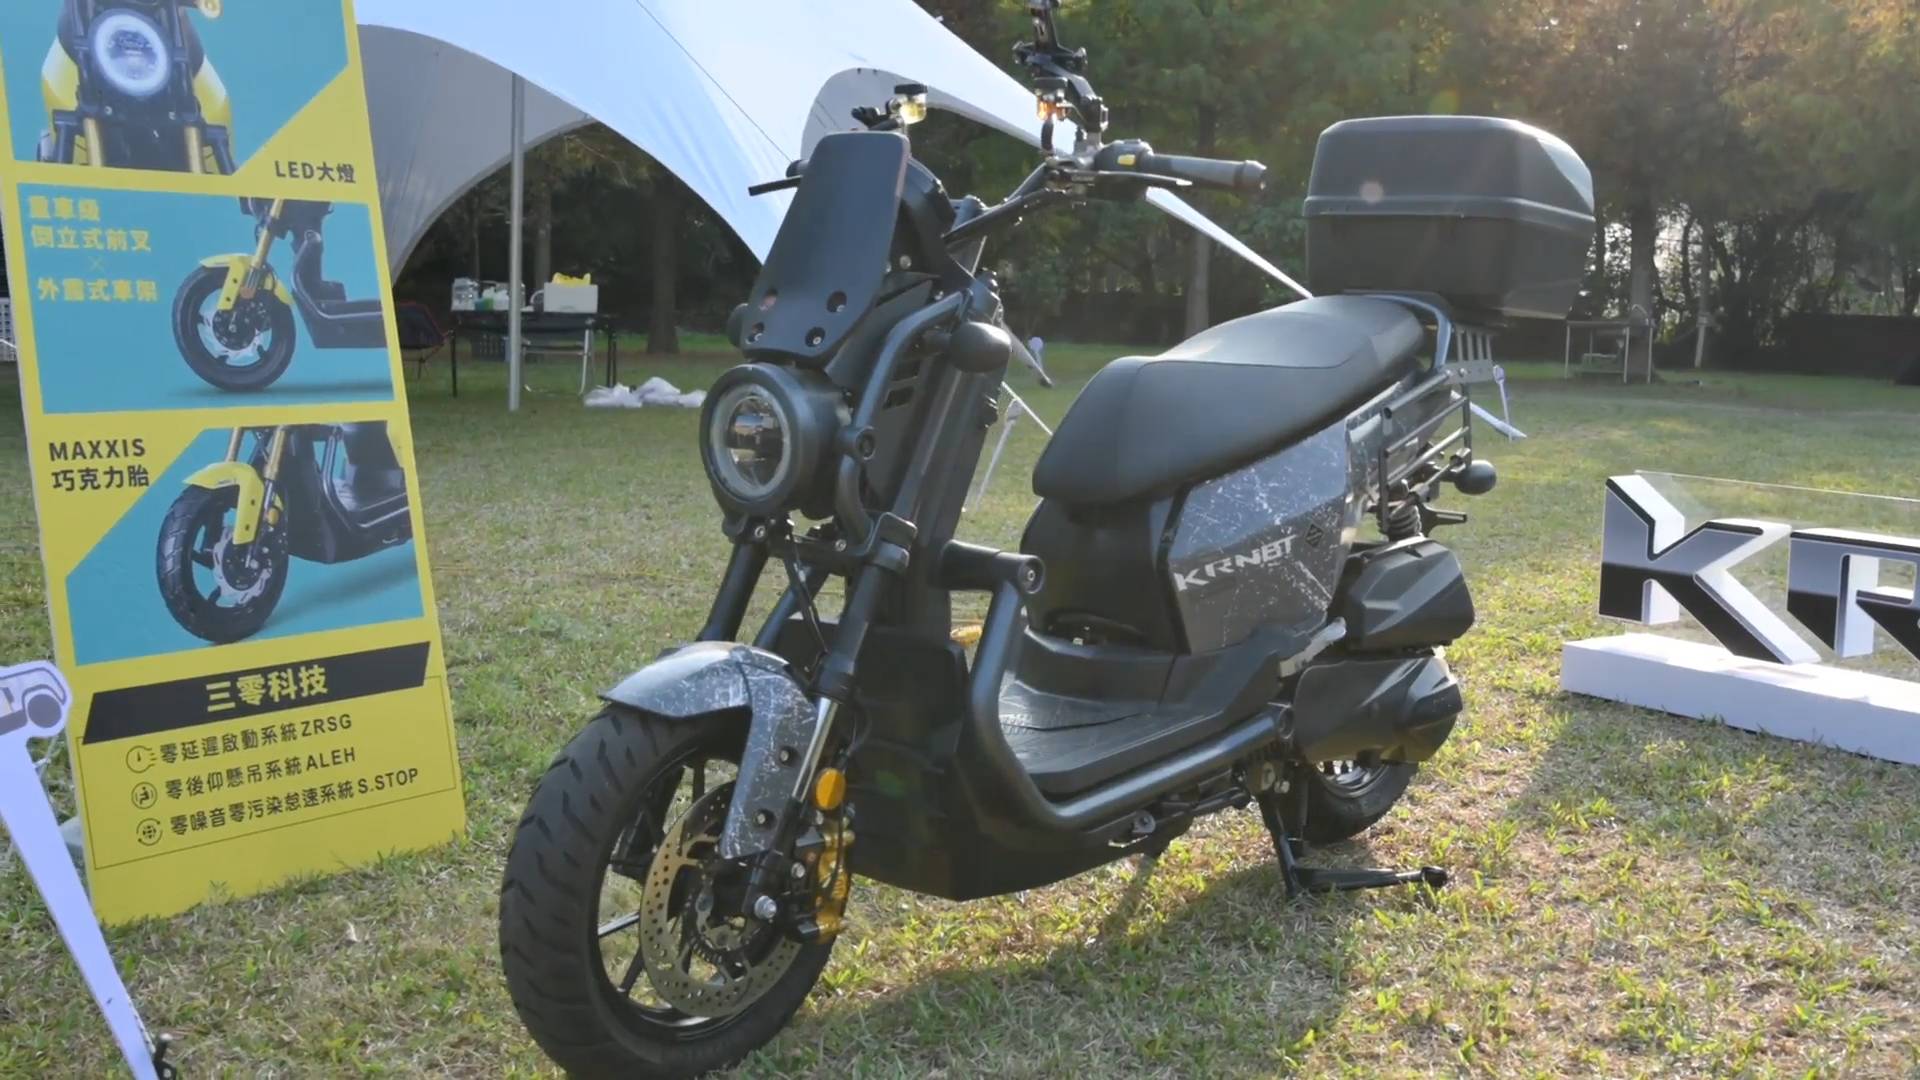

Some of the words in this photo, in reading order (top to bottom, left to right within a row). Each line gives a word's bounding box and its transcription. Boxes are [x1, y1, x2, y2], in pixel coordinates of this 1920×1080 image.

[274, 160, 356, 184] LED大燈
[49, 438, 145, 461] MAXXIS
[51, 464, 149, 492] 巧克力胎
[1173, 534, 1297, 592] KRNBT
[206, 664, 328, 712] 三零科技
